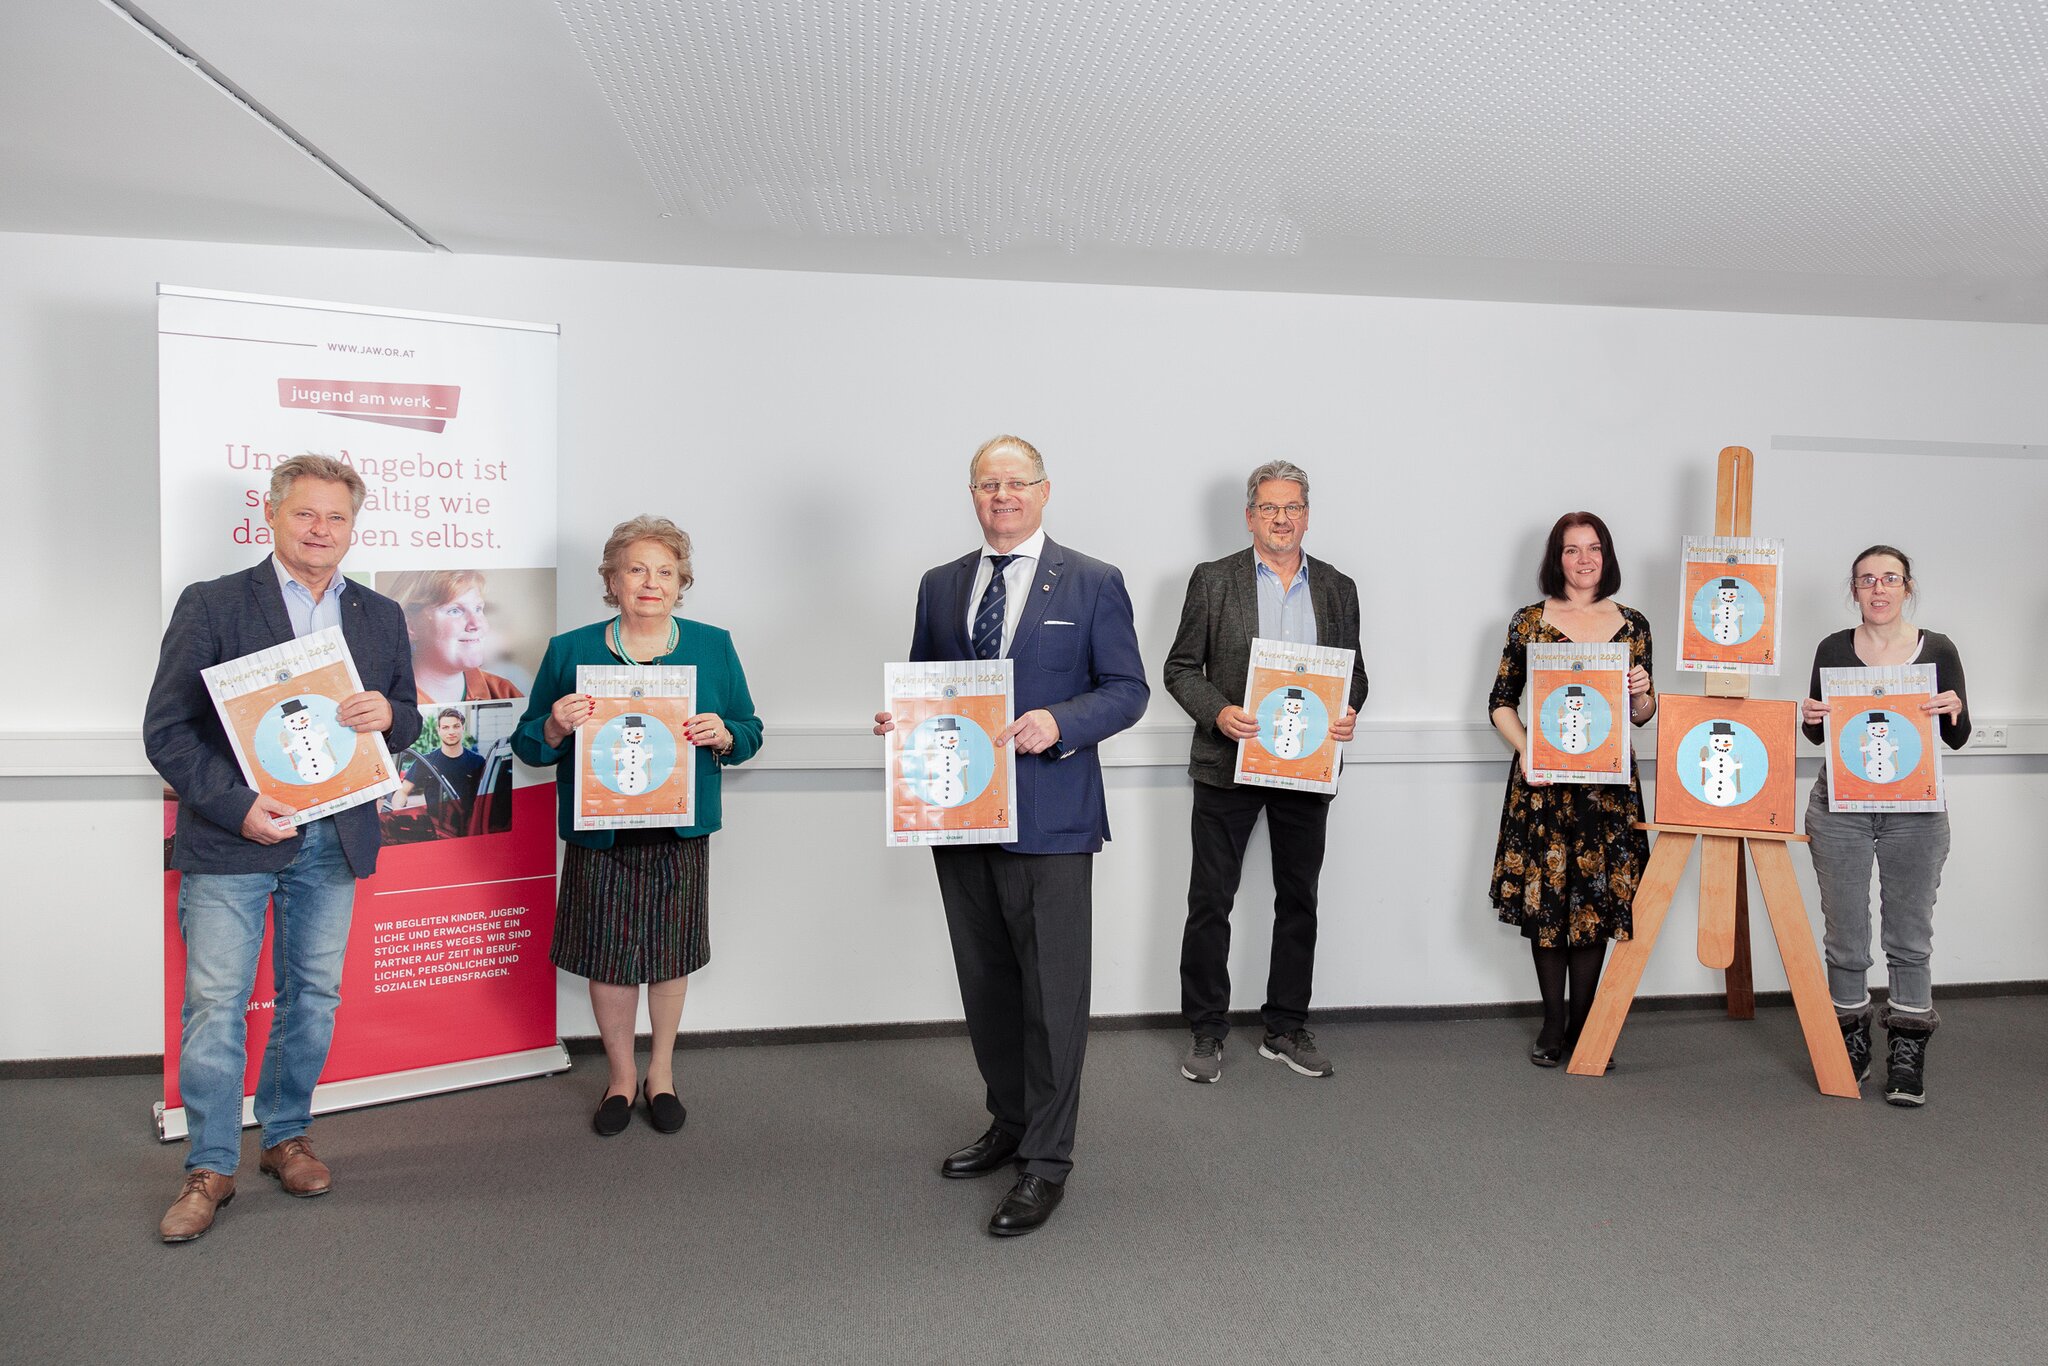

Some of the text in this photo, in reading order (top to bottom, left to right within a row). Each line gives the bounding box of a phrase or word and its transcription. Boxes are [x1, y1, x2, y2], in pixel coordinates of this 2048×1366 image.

[327, 342, 416, 358] WWW.JAW.OR.AT
[291, 385, 431, 408] jugend am werk
[340, 449, 464, 483] Angebot
[474, 458, 508, 481] ist
[439, 492, 491, 514] wie
[233, 518, 273, 544] da
[410, 523, 501, 549] selbst.
[374, 907, 530, 931] WIR BEGLEITEN KINDER, JUGEND-
[374, 919, 520, 944] LICHE UND ERWACHSENE EIN
[374, 930, 532, 956] STÜCK IHRES WEGES. WIR SIND
[374, 943, 521, 968] PARTNER AUF ZEIT IN BERUF-
[374, 954, 519, 981] LICHEN, PERSÖNLICHEN UND
[374, 968, 510, 993] SOZIALEN LEBENSFRAGEN.
